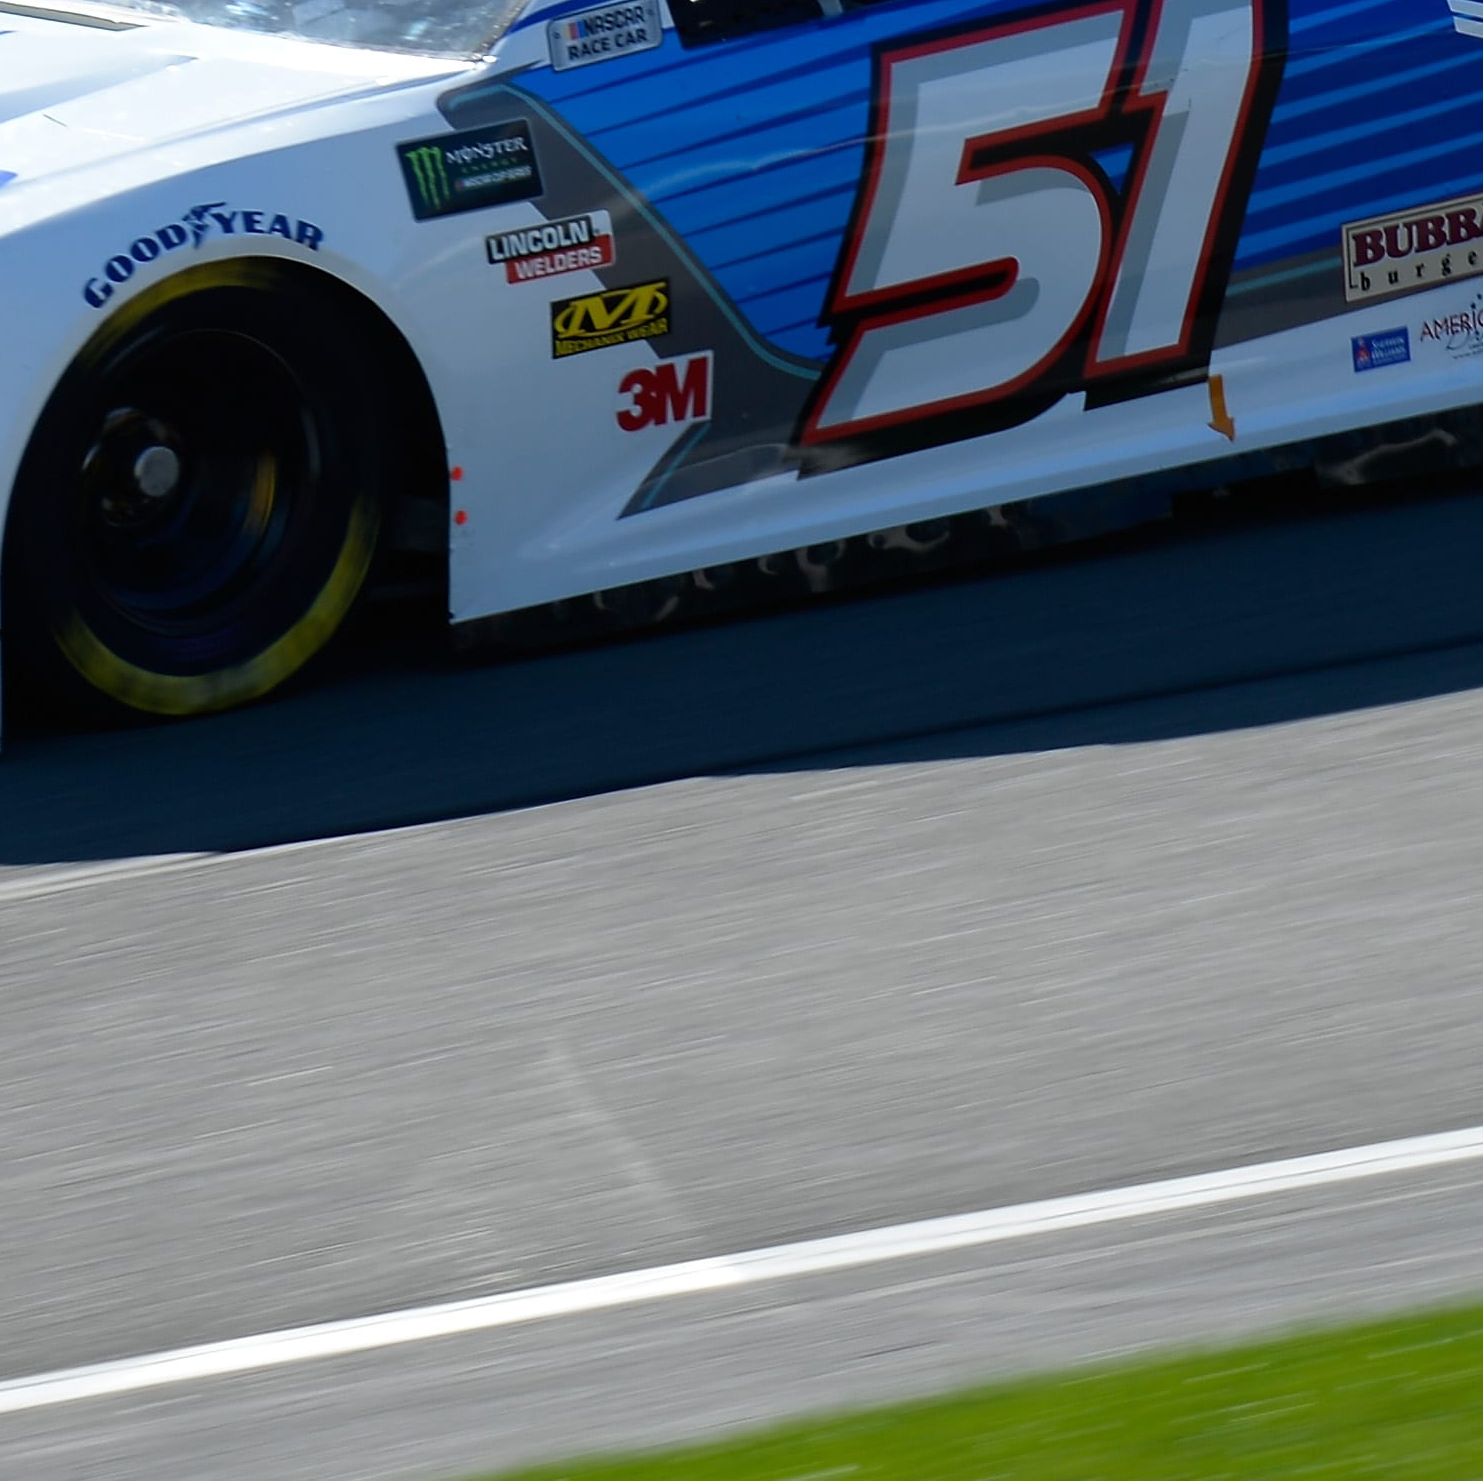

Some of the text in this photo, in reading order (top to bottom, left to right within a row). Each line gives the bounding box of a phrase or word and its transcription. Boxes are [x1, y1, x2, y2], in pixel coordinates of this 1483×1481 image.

[583, 5, 646, 36] NASCAR
[566, 28, 649, 61] RACE CAR
[444, 135, 530, 165] MONSTER
[488, 217, 592, 263] LINCOLN
[514, 245, 603, 279] WELDERS
[616, 356, 710, 434] 3M
